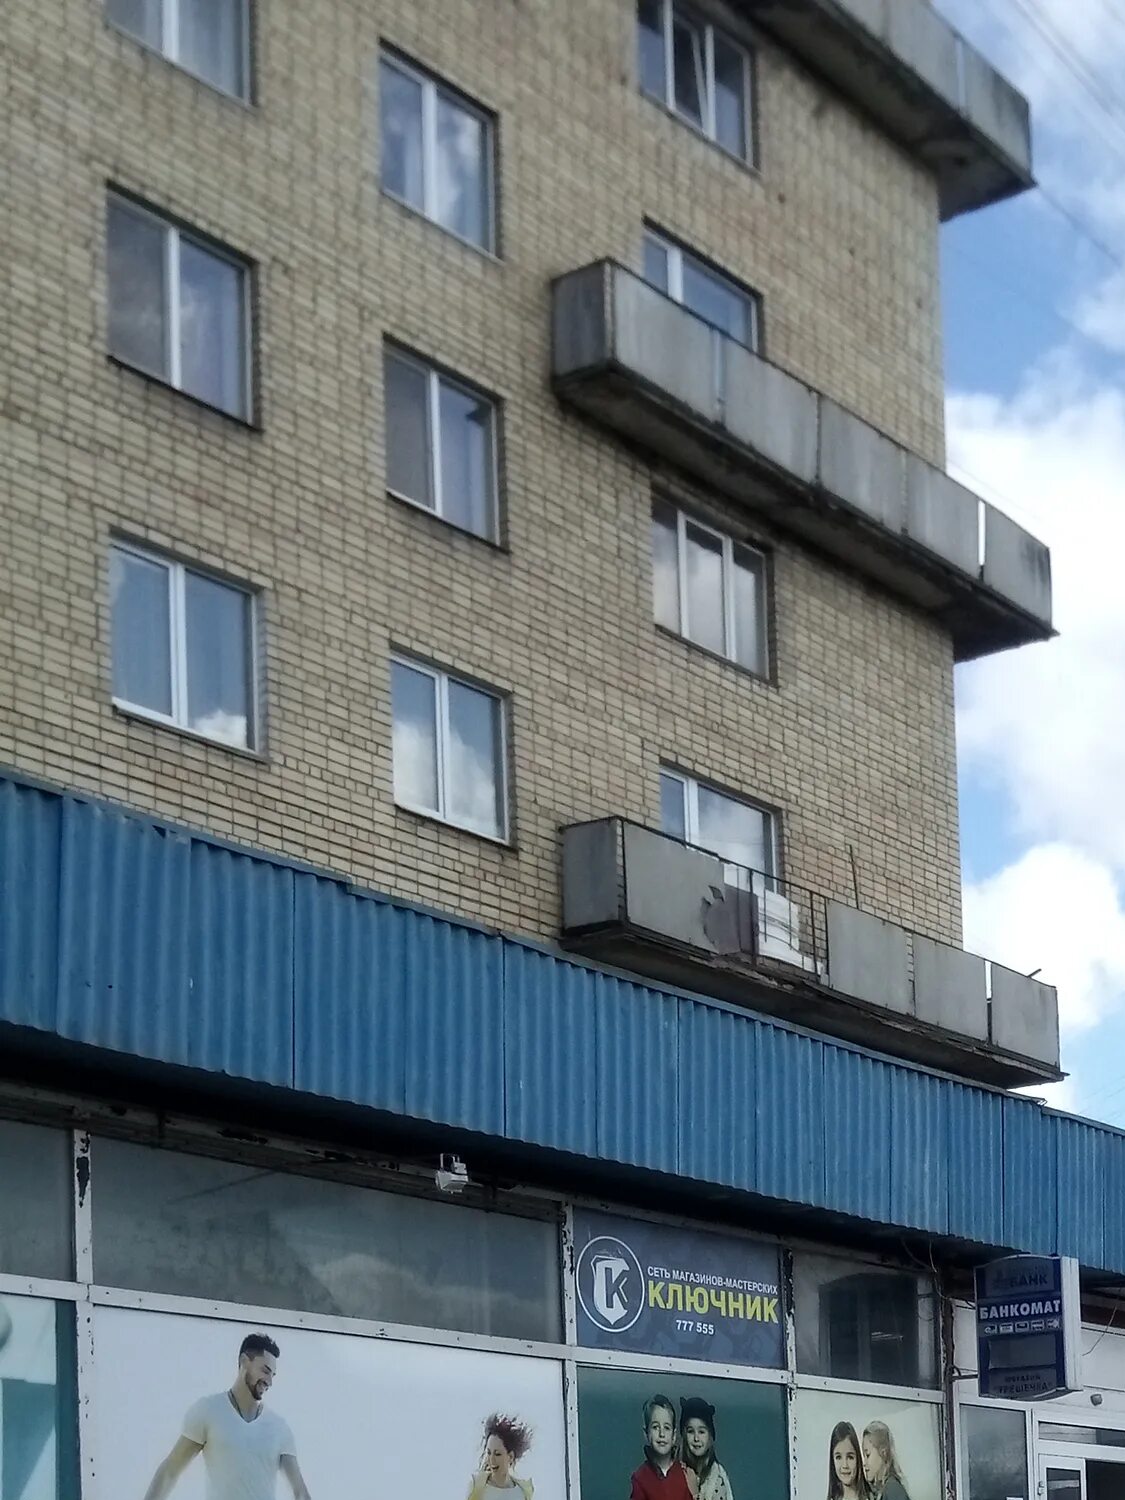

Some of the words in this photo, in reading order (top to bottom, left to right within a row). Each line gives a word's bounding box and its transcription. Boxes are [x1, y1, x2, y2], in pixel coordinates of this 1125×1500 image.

[647, 1265, 671, 1279] СЕТЬ
[672, 1269, 779, 1296] МАГАЗИНОВ-МАСТЕРСКИХ
[647, 1280, 780, 1324] КЛЮЧНИК
[979, 1299, 1061, 1320] БАНКОМАТ
[675, 1319, 695, 1333] 777
[695, 1322, 716, 1336] 555
